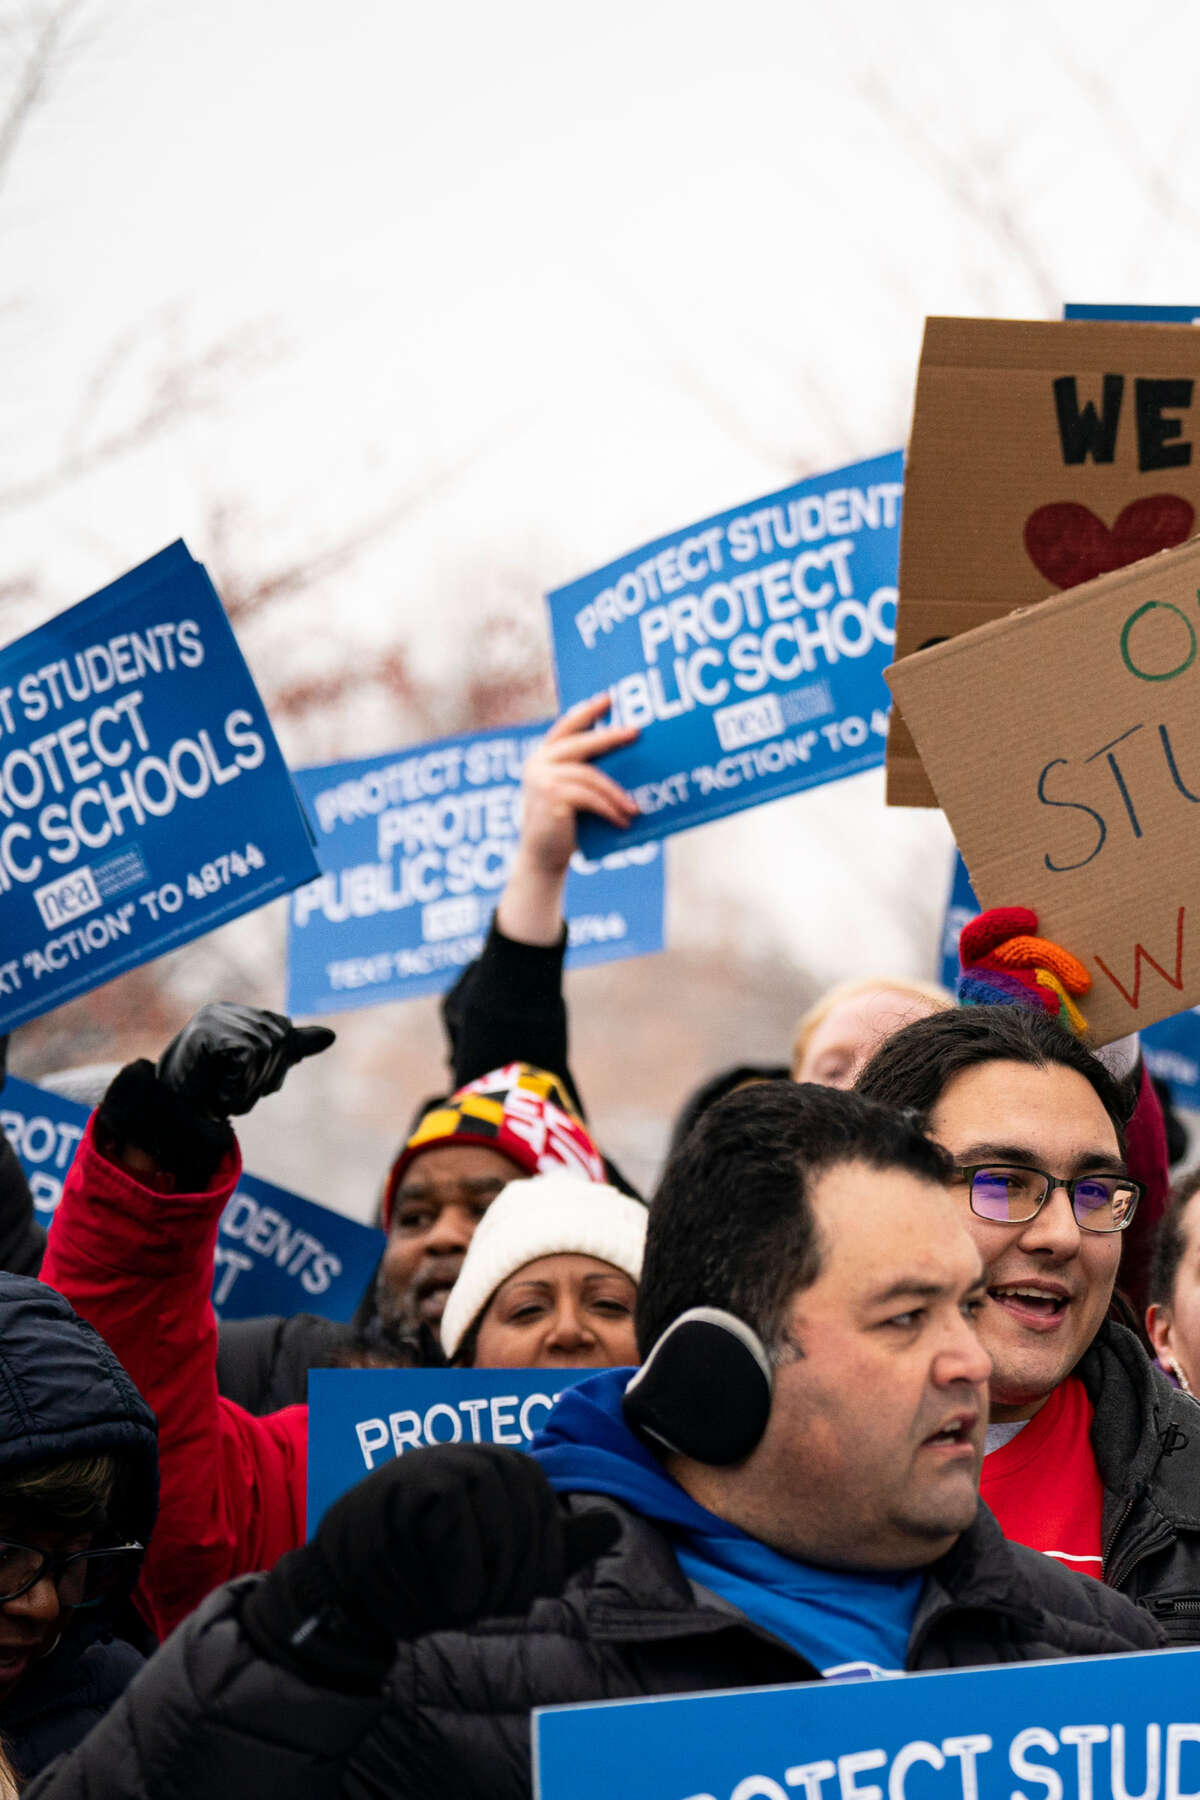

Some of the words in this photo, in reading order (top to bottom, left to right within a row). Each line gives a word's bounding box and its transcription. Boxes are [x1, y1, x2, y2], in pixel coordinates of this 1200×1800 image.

[1053, 374, 1194, 472] WE
[574, 526, 724, 650] PROTECT
[726, 482, 905, 562] STUDENT
[638, 540, 855, 664] PROTECT
[18, 619, 205, 721] STUDENTS
[728, 587, 898, 691] SCHOO
[0, 690, 149, 819] OTECT
[38, 709, 266, 863] SCHOOLS
[633, 771, 690, 815] EXT
[820, 716, 869, 751] TO
[140, 883, 183, 921] TO
[187, 842, 266, 900] 48744
[294, 850, 444, 927] PUBLIC
[222, 1192, 342, 1295] DENTS
[355, 1392, 560, 1470] PROTEC
